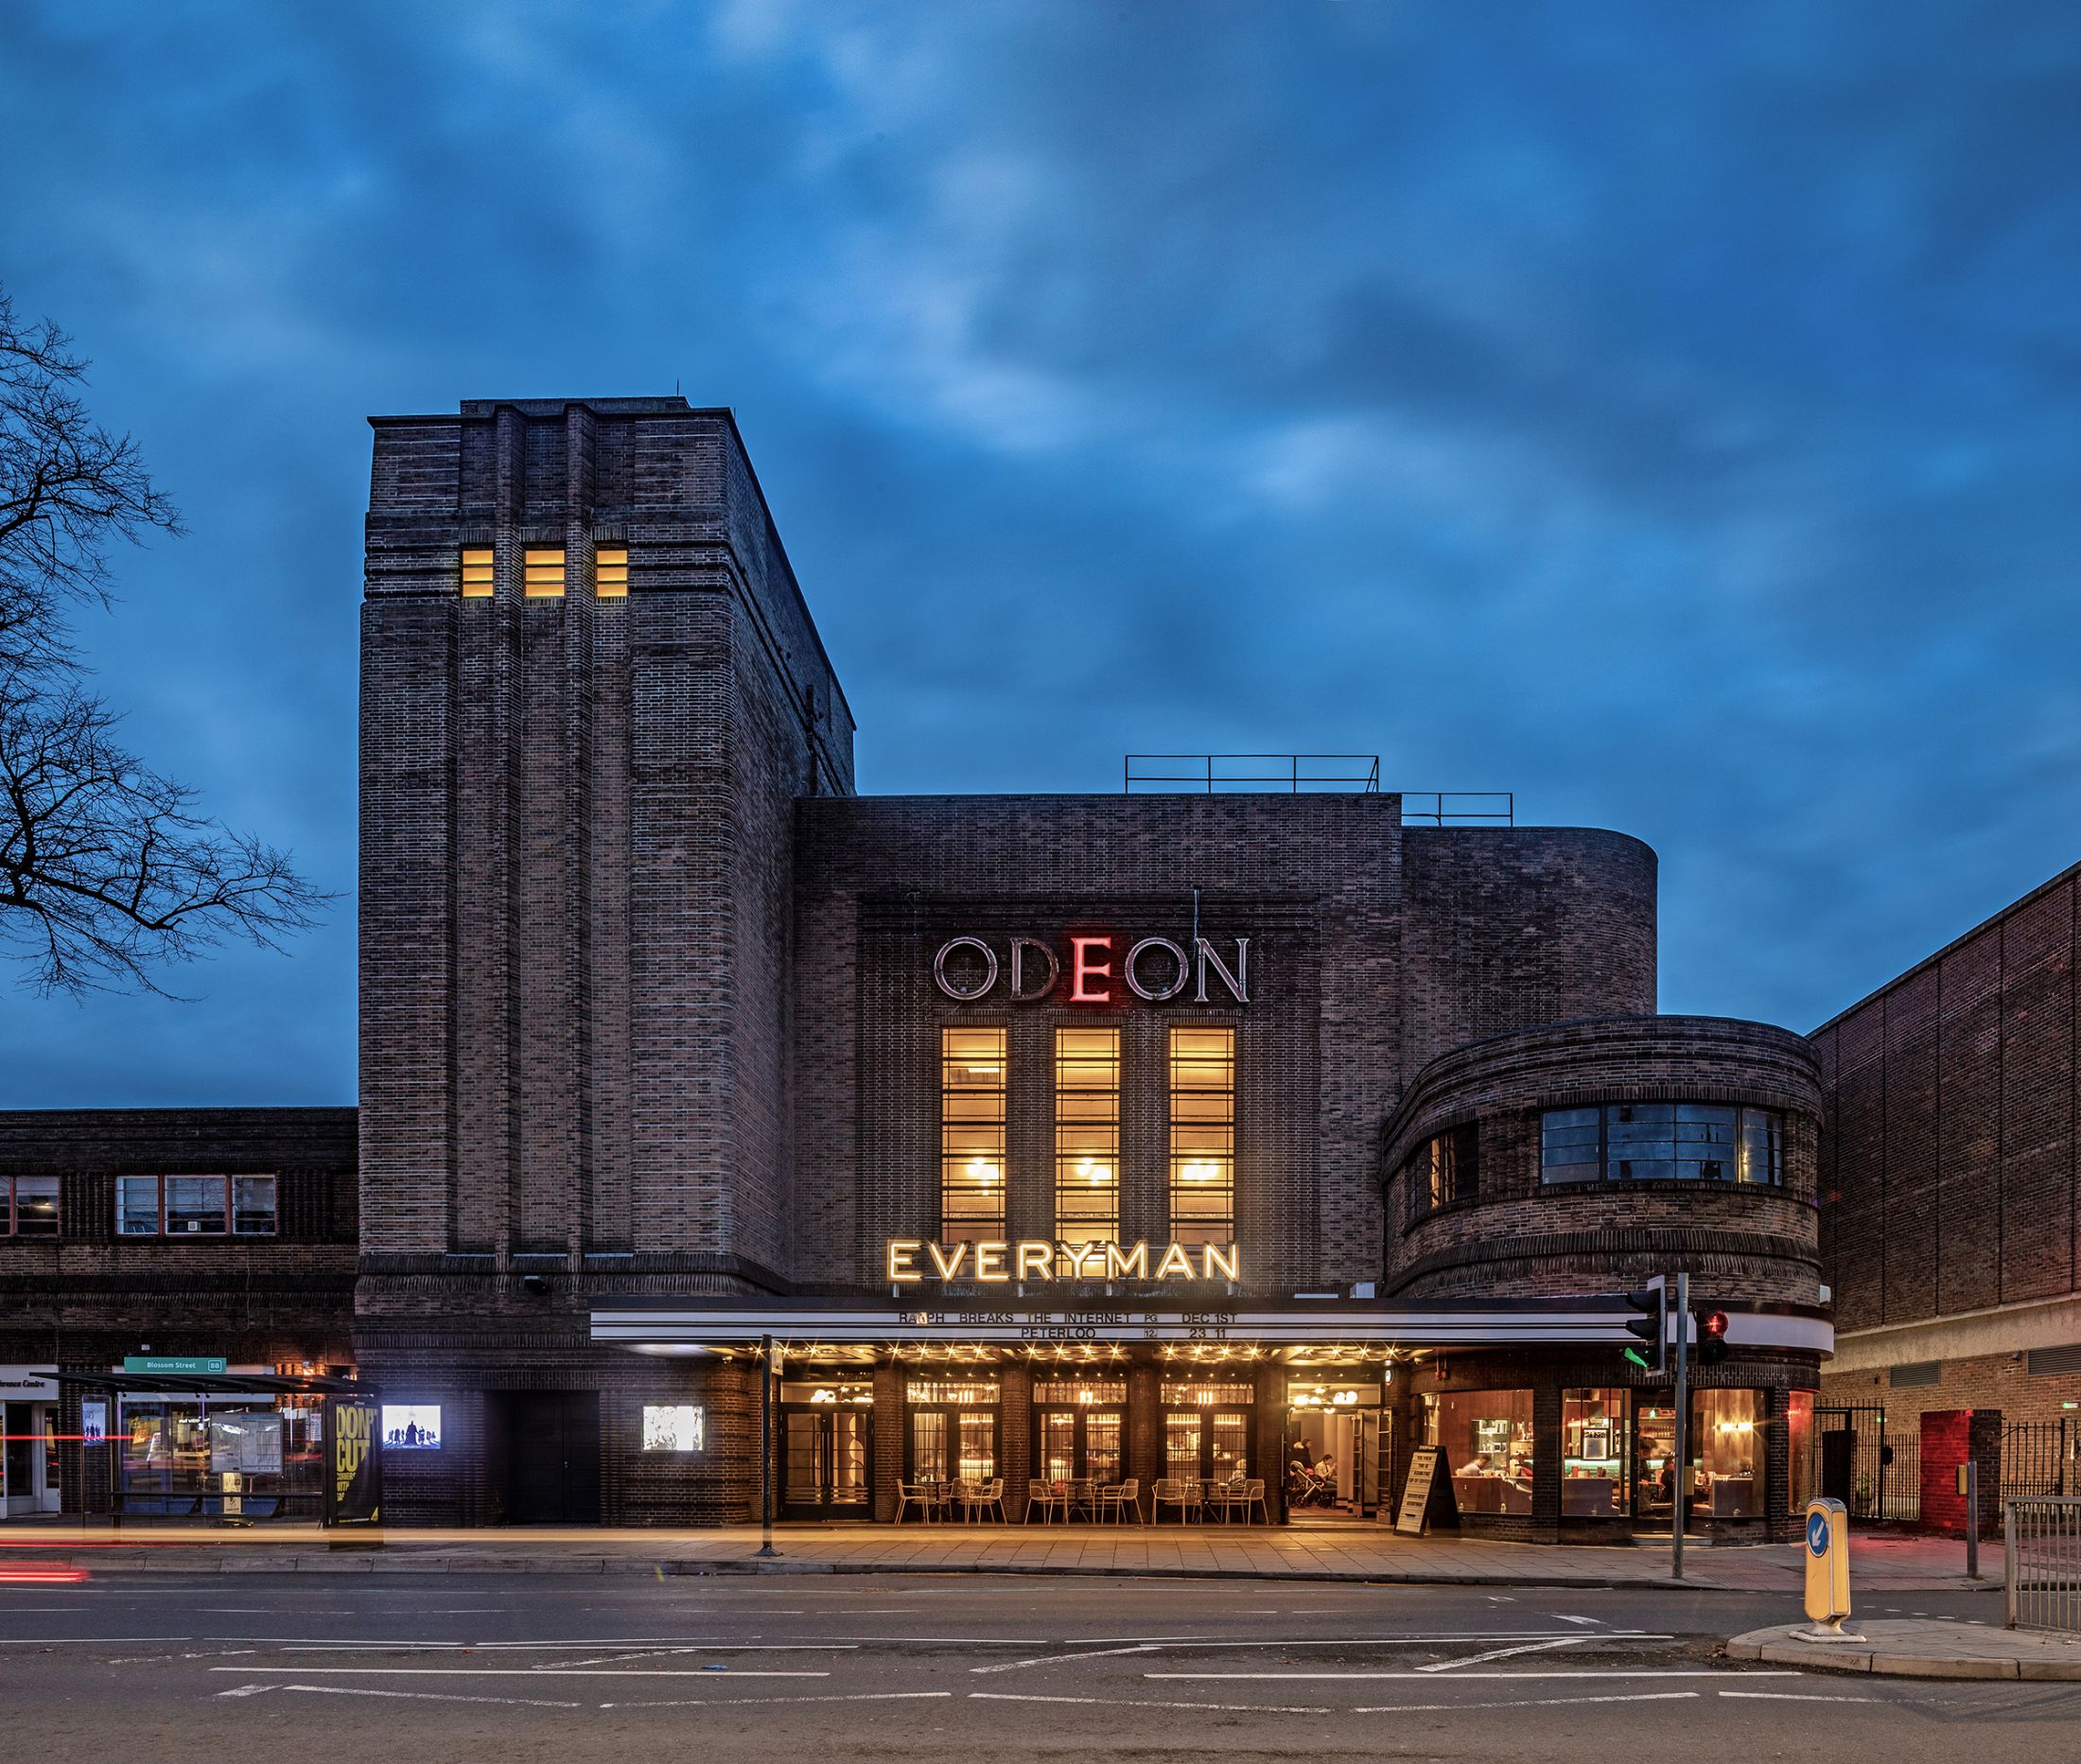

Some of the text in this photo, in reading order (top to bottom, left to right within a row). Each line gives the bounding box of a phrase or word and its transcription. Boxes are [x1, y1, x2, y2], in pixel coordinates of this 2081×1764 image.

[933, 936, 1250, 1003] ODEON
[886, 1239, 1241, 1283] EVERYMAN
[900, 1312, 1236, 1324] RAPH BREAKS THE INTERNET PG DEC 1ST
[1021, 1327, 1096, 1339] PETERLOO
[1189, 1328, 1206, 1339] 23
[1215, 1328, 1227, 1339] 11
[23, 1379, 45, 1388] Centre
[336, 1438, 370, 1473] CUT
